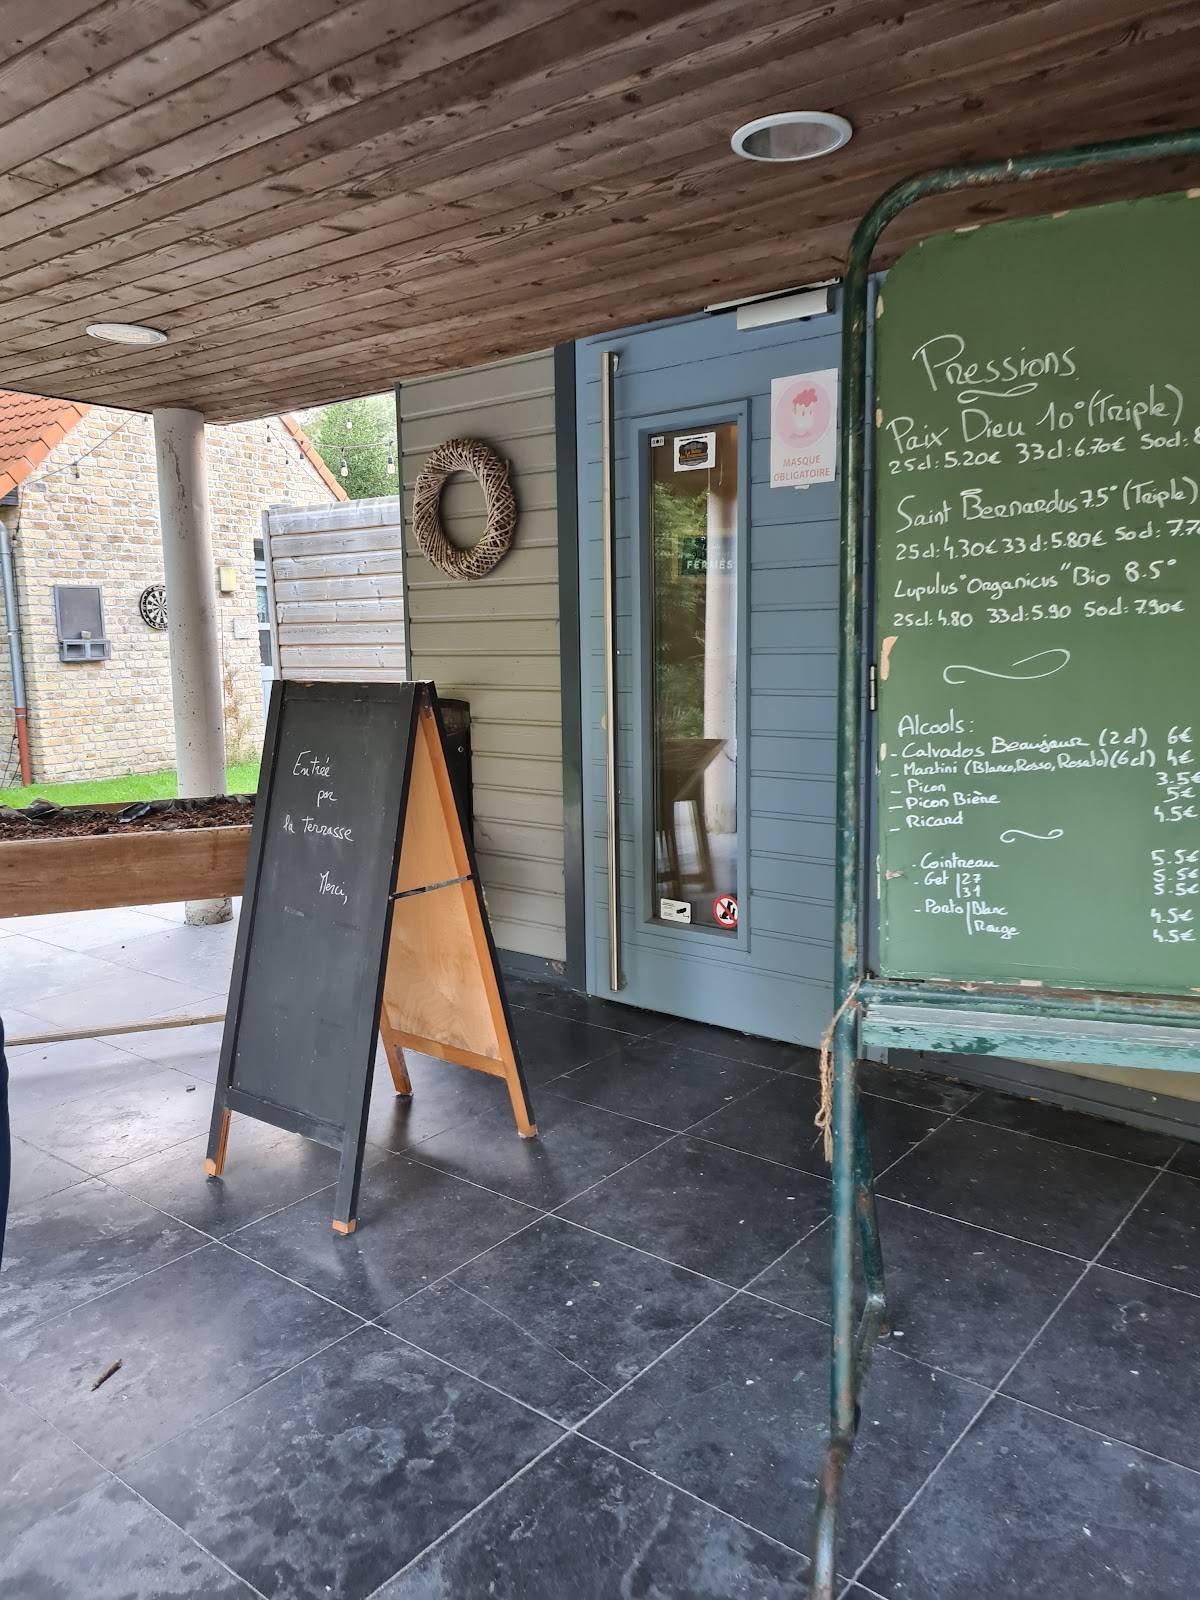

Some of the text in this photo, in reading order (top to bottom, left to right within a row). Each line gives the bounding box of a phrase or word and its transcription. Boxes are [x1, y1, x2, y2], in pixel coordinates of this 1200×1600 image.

[886, 416, 949, 454] Paix
[961, 408, 1026, 443] Dieu
[783, 455, 821, 466] MASQUE
[774, 467, 831, 482] OBLIGATOIRE
[896, 494, 952, 533] Saint
[960, 488, 1078, 520] Bernardus
[894, 571, 958, 602] Lupulus
[901, 741, 986, 759] Calvados
[1167, 725, 1193, 745] 6€
[903, 760, 958, 776] Martini
[1166, 749, 1195, 767] 4€
[906, 778, 947, 794] Picon
[317, 789, 338, 808] par
[905, 786, 1196, 810] Picon Bière 5€
[283, 814, 295, 834] la
[905, 810, 964, 828] Ricard
[920, 851, 1001, 870] Cointreau
[924, 869, 950, 886] Get
[962, 884, 981, 898] 31
[924, 898, 964, 914] Porto
